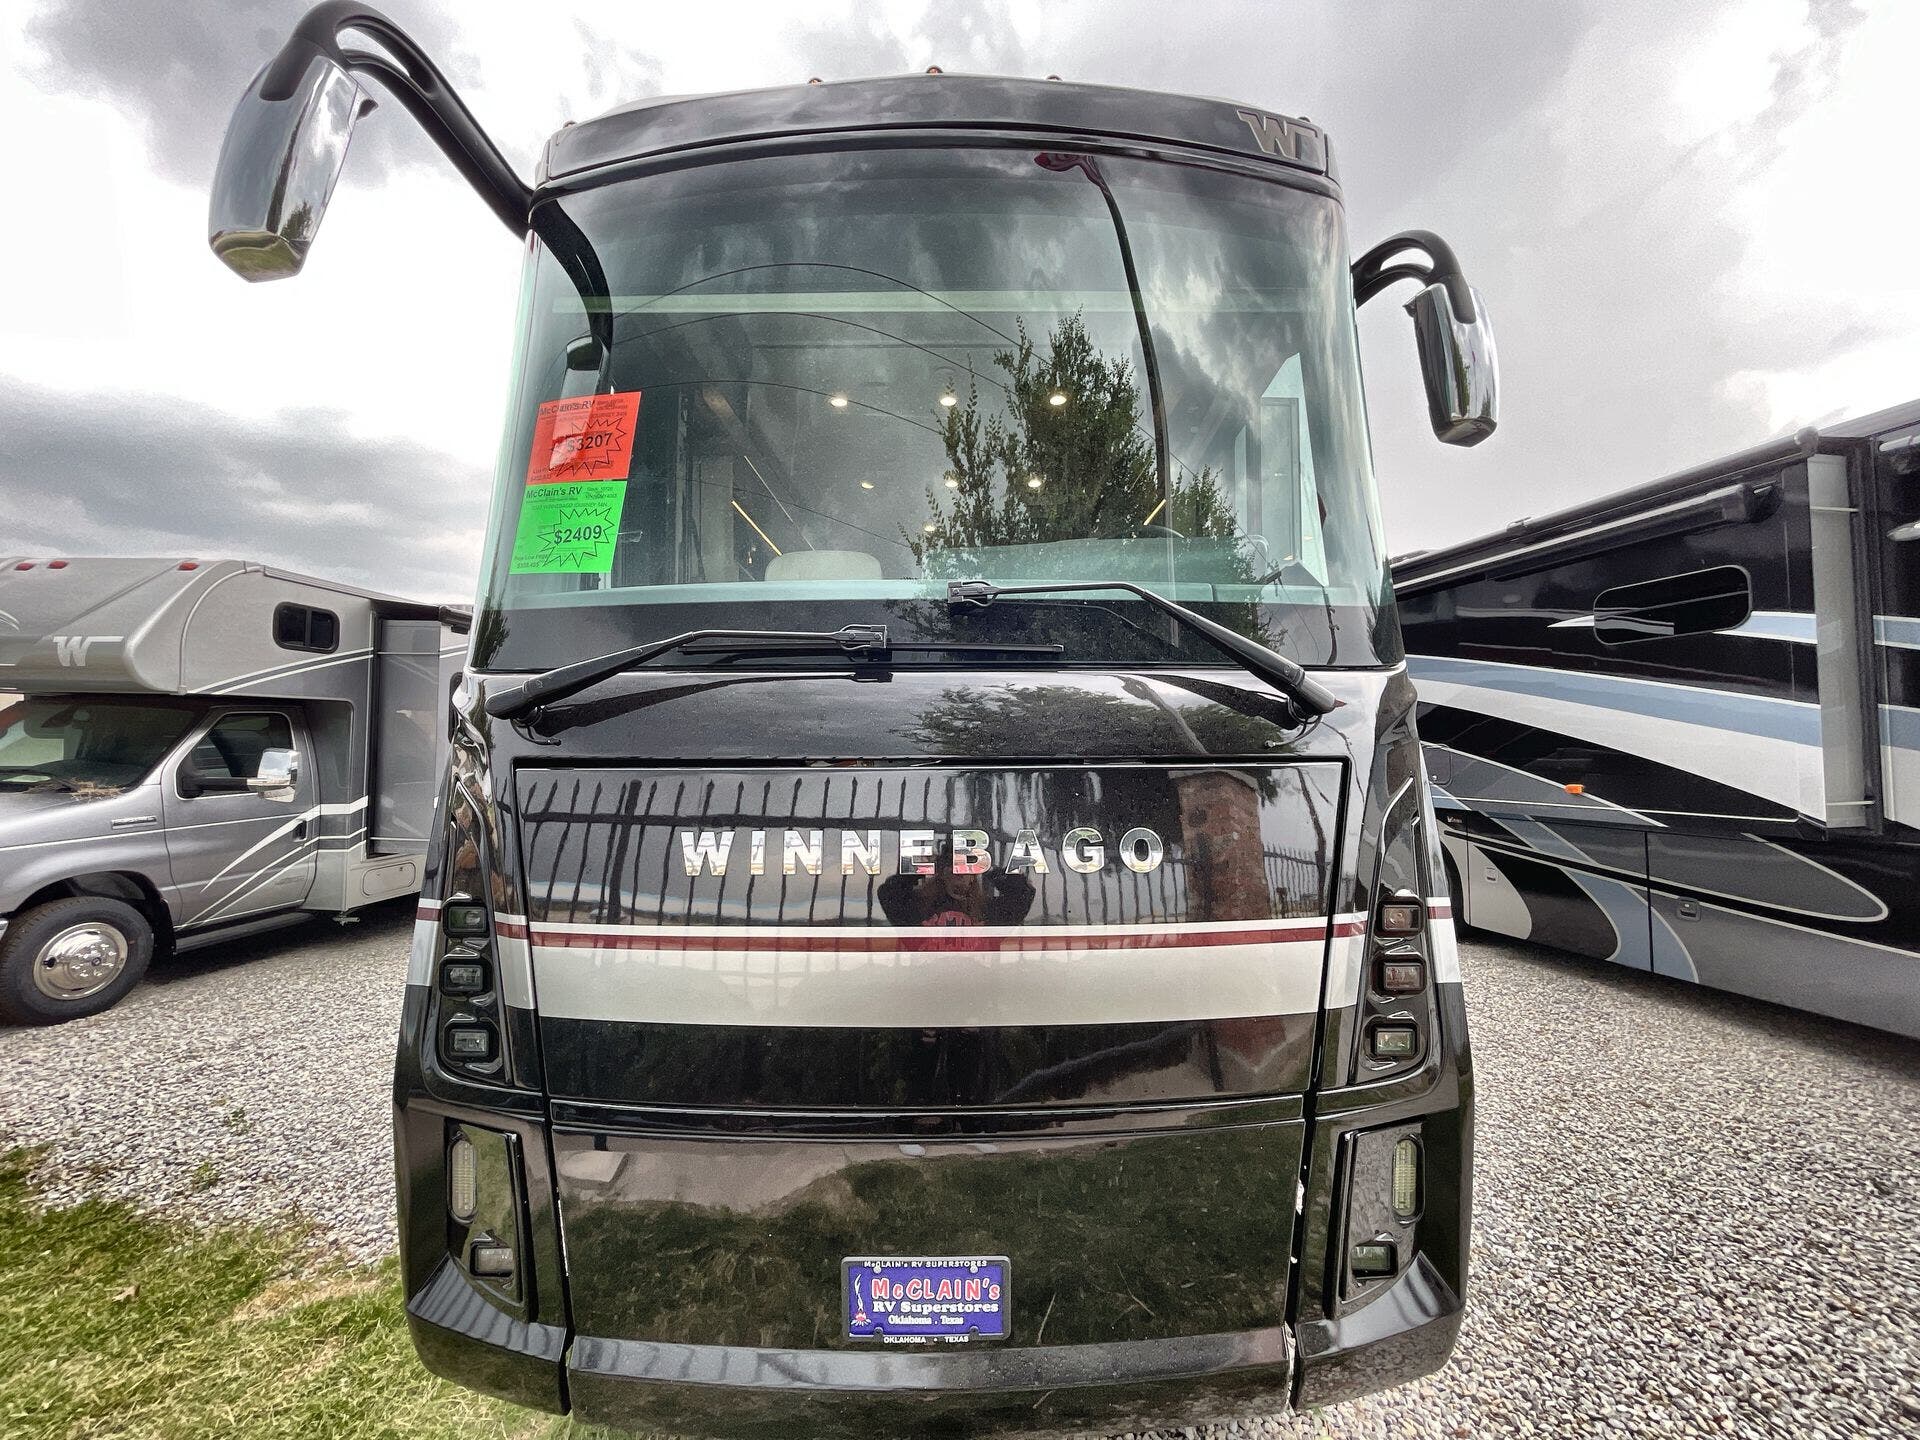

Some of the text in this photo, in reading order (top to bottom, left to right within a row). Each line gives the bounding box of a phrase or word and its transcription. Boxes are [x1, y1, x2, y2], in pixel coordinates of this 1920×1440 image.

[567, 433, 613, 452] $3207
[526, 487, 566, 499] McClain's
[568, 486, 583, 496] RV
[554, 525, 603, 545] $2409
[680, 826, 1165, 876] WINNEBAGO
[911, 1260, 924, 1268] RV
[925, 1260, 988, 1268] SUPERSTORES
[872, 1301, 999, 1315] RV Superstores
[888, 1315, 964, 1325] Oklahoma Texas
[884, 1336, 927, 1344] OKLAHOMA
